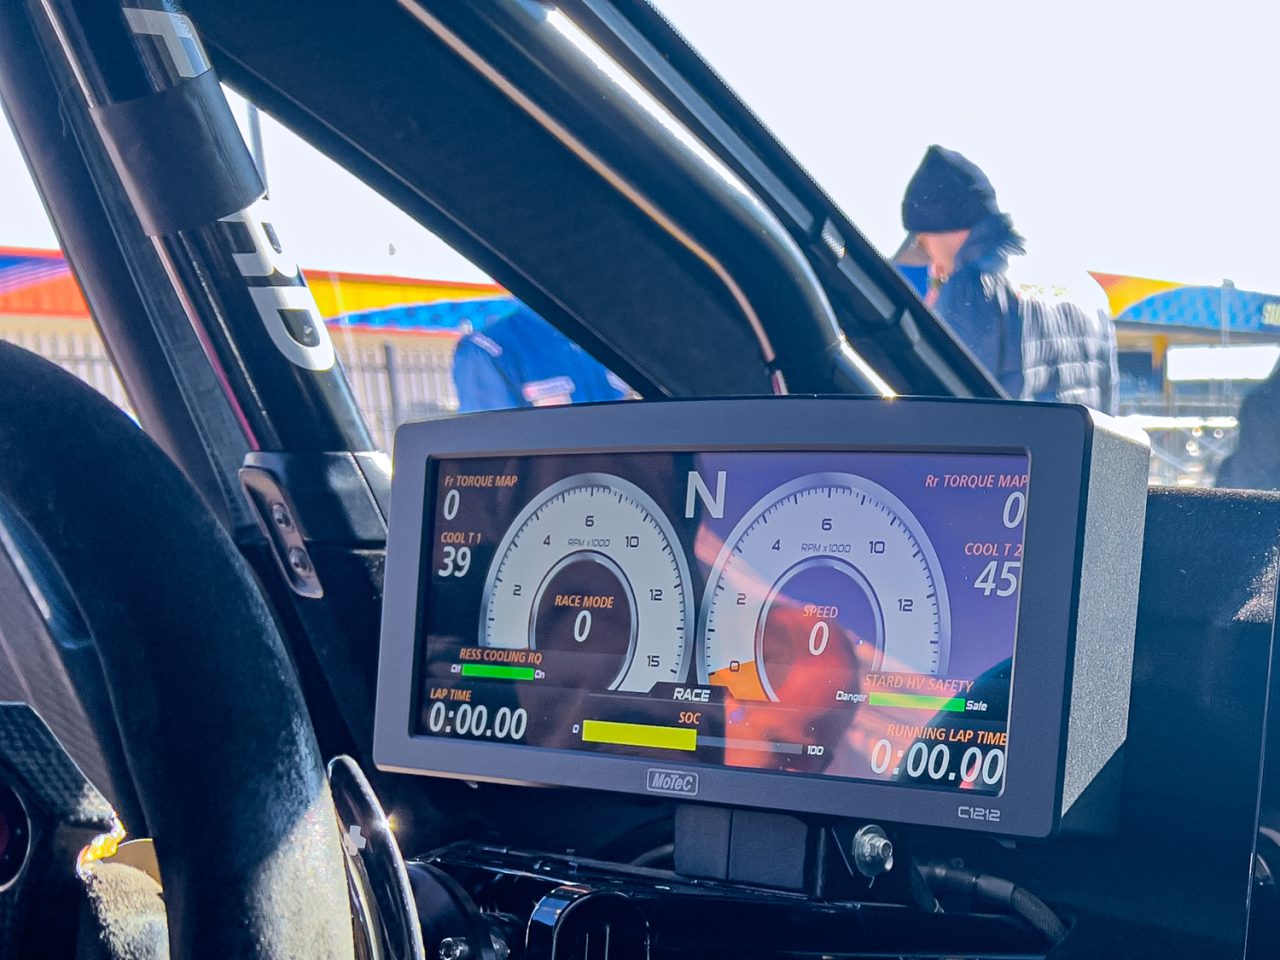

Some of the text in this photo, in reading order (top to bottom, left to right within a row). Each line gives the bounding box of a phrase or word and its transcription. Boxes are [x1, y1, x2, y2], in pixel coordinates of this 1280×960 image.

[444, 475, 518, 488] Fr TORQUE MAP
[925, 474, 1028, 490] Rr TORQUE MAP
[684, 470, 727, 519] N
[443, 489, 460, 520] 0
[1002, 491, 1024, 529] 0
[585, 515, 594, 527] 6
[821, 518, 832, 532] 6
[441, 532, 482, 544] COOL T 1
[543, 535, 551, 547] 4
[568, 538, 585, 547] RPM
[625, 536, 639, 548] 10
[771, 539, 781, 552] 4
[801, 543, 851, 554] RPM x1000
[869, 540, 885, 555] 10
[964, 542, 1023, 557] COOL T 2
[438, 546, 472, 578] 39
[973, 560, 1021, 598] 45
[513, 584, 522, 596] 2
[649, 588, 663, 601] 12
[555, 594, 614, 609] RACE MODE
[737, 593, 747, 606] 2
[897, 598, 914, 613] 12
[802, 605, 838, 619] SPEED
[573, 610, 591, 642] 0
[808, 620, 829, 657] 0
[459, 648, 543, 666] RESS COOLING RQ
[647, 655, 660, 667] 15
[729, 660, 740, 673] 0
[864, 673, 974, 694] STARD HV SAFETY
[430, 688, 472, 702] LAP TIME
[673, 687, 711, 703] RACE
[835, 690, 867, 705] Danger
[965, 700, 988, 712] Safe
[429, 701, 528, 740] 0:00.00
[678, 711, 701, 725] SOC
[572, 724, 579, 734] 0
[887, 723, 1008, 746] RUNNING LAP TIME
[806, 745, 824, 757] 100
[870, 738, 1004, 785] 0:00.00
[652, 773, 693, 792] MoTeC
[957, 805, 1001, 822] C1212
